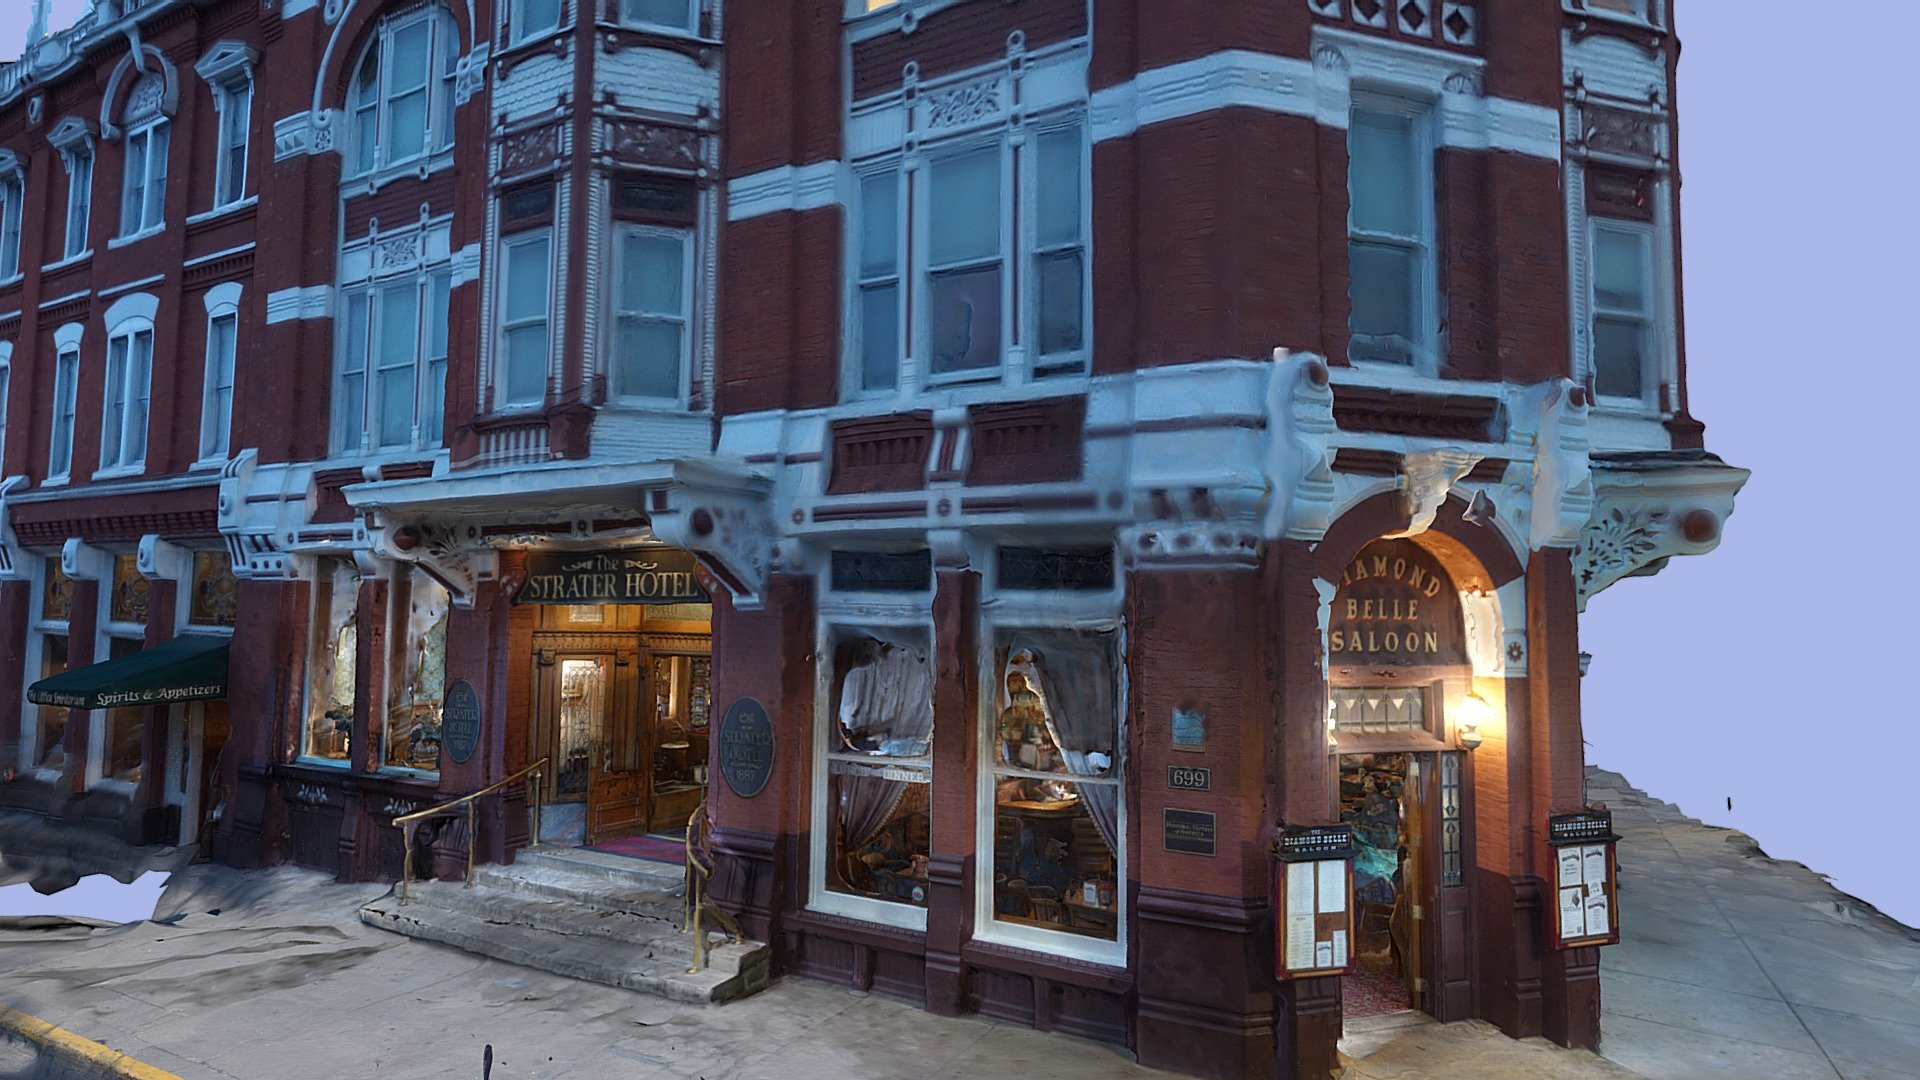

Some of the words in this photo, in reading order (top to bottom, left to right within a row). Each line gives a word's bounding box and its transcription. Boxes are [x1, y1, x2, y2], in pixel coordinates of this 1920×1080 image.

[597, 555, 620, 571] The
[530, 573, 618, 600] STRATER
[625, 571, 698, 598] HOTEL
[1336, 556, 1440, 598] IAMOND
[1346, 598, 1418, 620] BELLE
[1331, 630, 1438, 653] SALOON
[96, 692, 140, 706] Spirits
[143, 689, 155, 700] &
[156, 684, 222, 700] Appetizers
[1173, 769, 1205, 787] 699
[1555, 822, 1586, 832] DIAMOND
[1587, 820, 1607, 829] BELLE
[1284, 836, 1321, 846] DIAMOND
[1323, 834, 1347, 844] BELLE
[1295, 845, 1336, 853] SALOON
